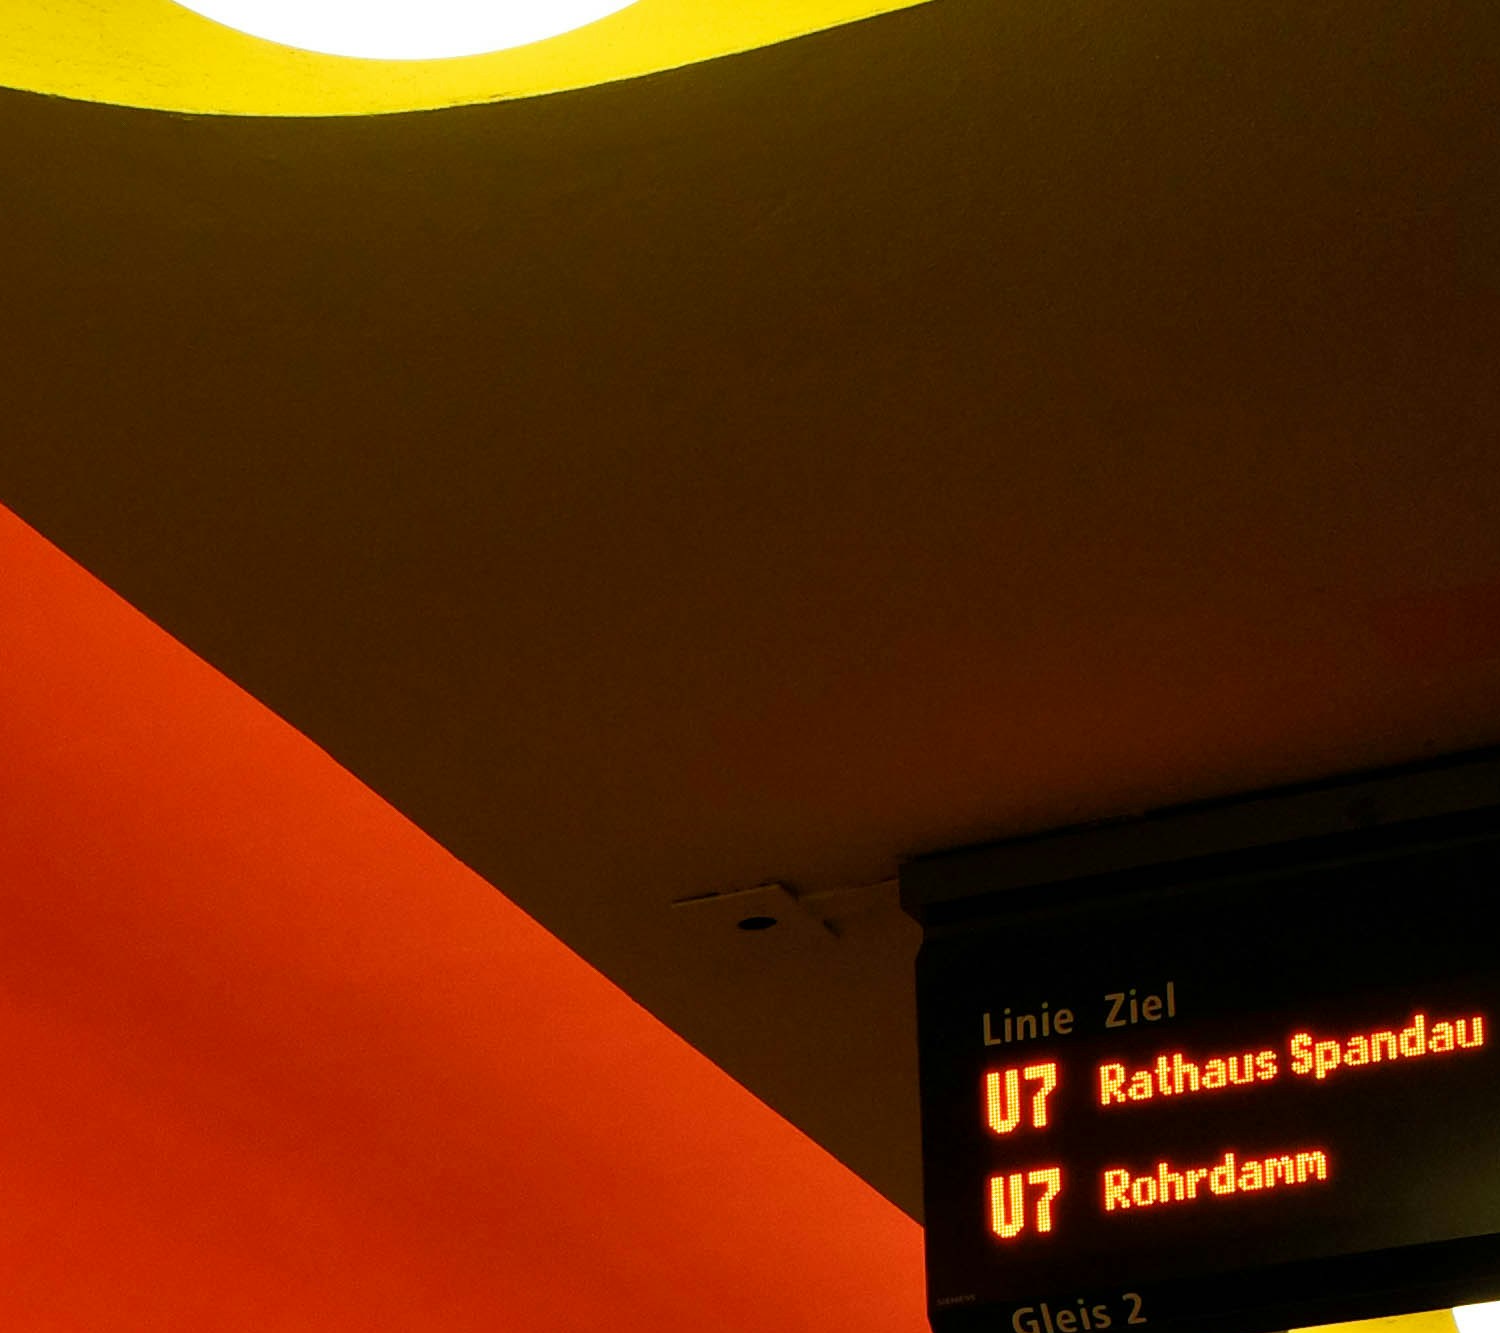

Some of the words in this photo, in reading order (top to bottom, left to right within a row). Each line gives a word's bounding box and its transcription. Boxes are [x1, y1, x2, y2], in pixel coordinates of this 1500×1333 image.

[982, 1000, 1076, 1048] Linie
[1103, 979, 1177, 1030] Ziel
[985, 1061, 1058, 1135] U7
[1098, 1050, 1279, 1107] Rathaus
[1289, 1013, 1485, 1080] Spandau
[989, 1166, 1063, 1240] U7
[1103, 1149, 1328, 1213] Rohrdamm
[1121, 1291, 1150, 1326] 2
